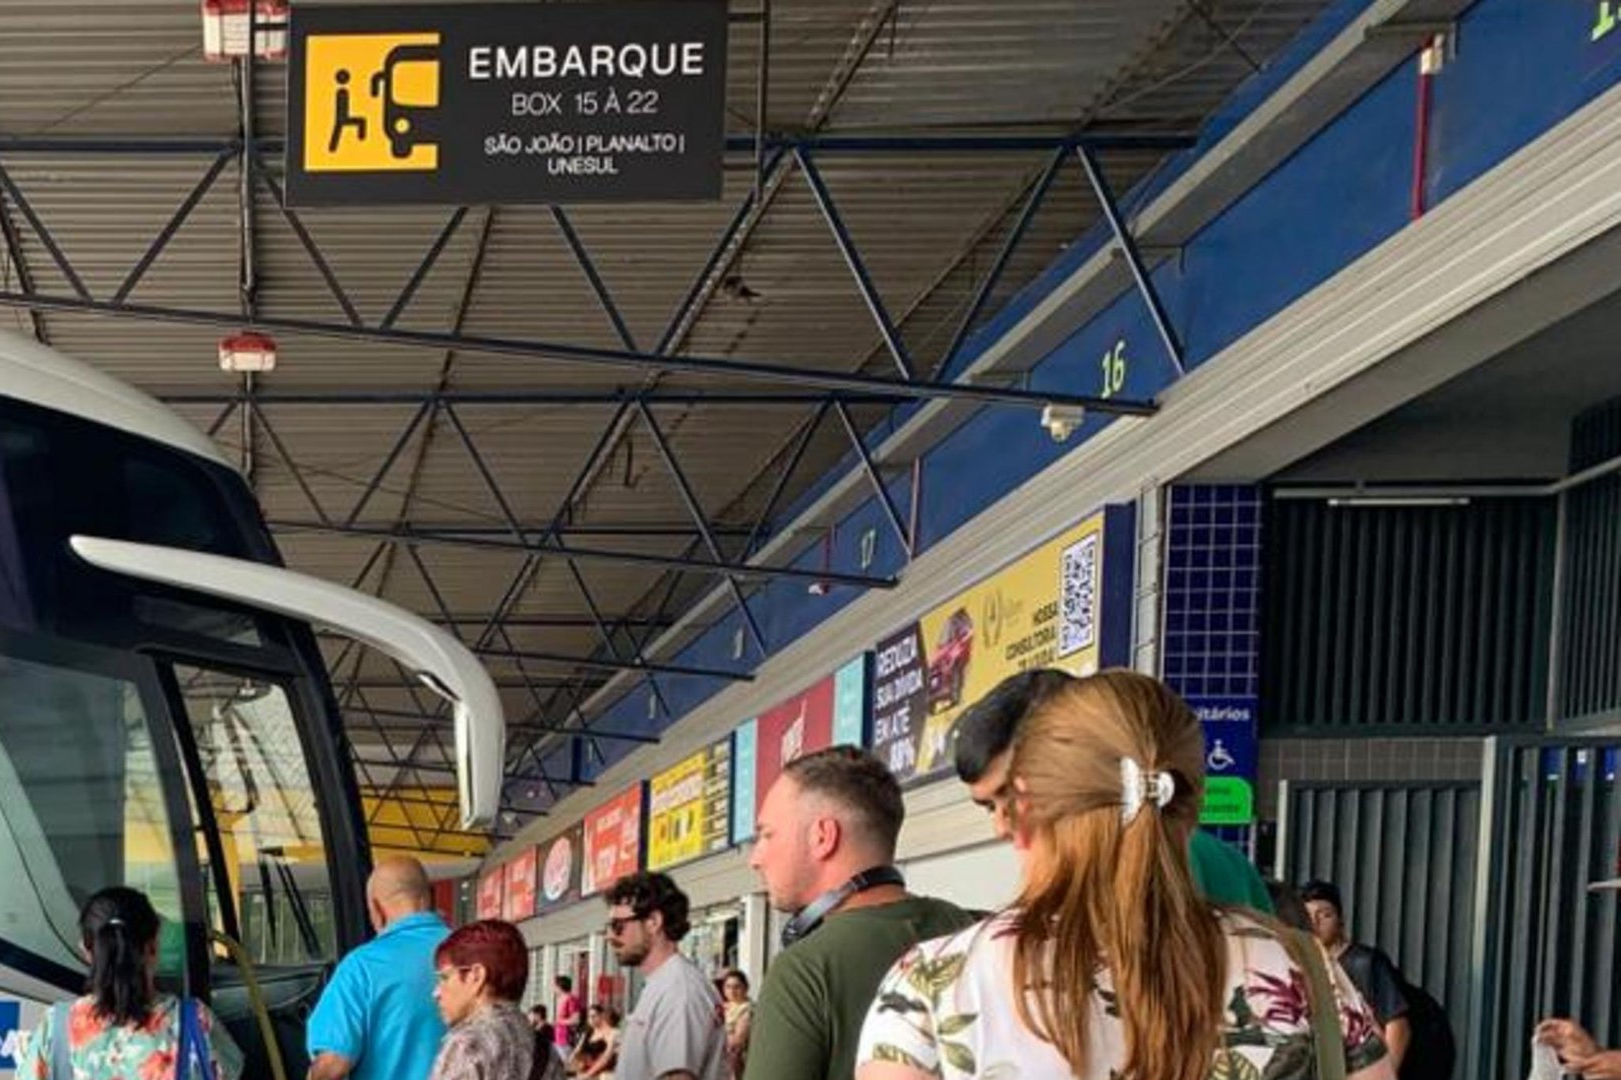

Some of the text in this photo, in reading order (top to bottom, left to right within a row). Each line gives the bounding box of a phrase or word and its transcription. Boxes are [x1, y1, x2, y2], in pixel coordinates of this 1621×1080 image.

[468, 42, 705, 79] EMBARQUE
[511, 86, 659, 116] BOX 15 À 22
[484, 133, 522, 154] SÃO
[525, 132, 575, 154] JOÃO
[585, 133, 678, 154] PLANALTO
[547, 156, 619, 174] UNESUL
[1101, 340, 1126, 399] 16
